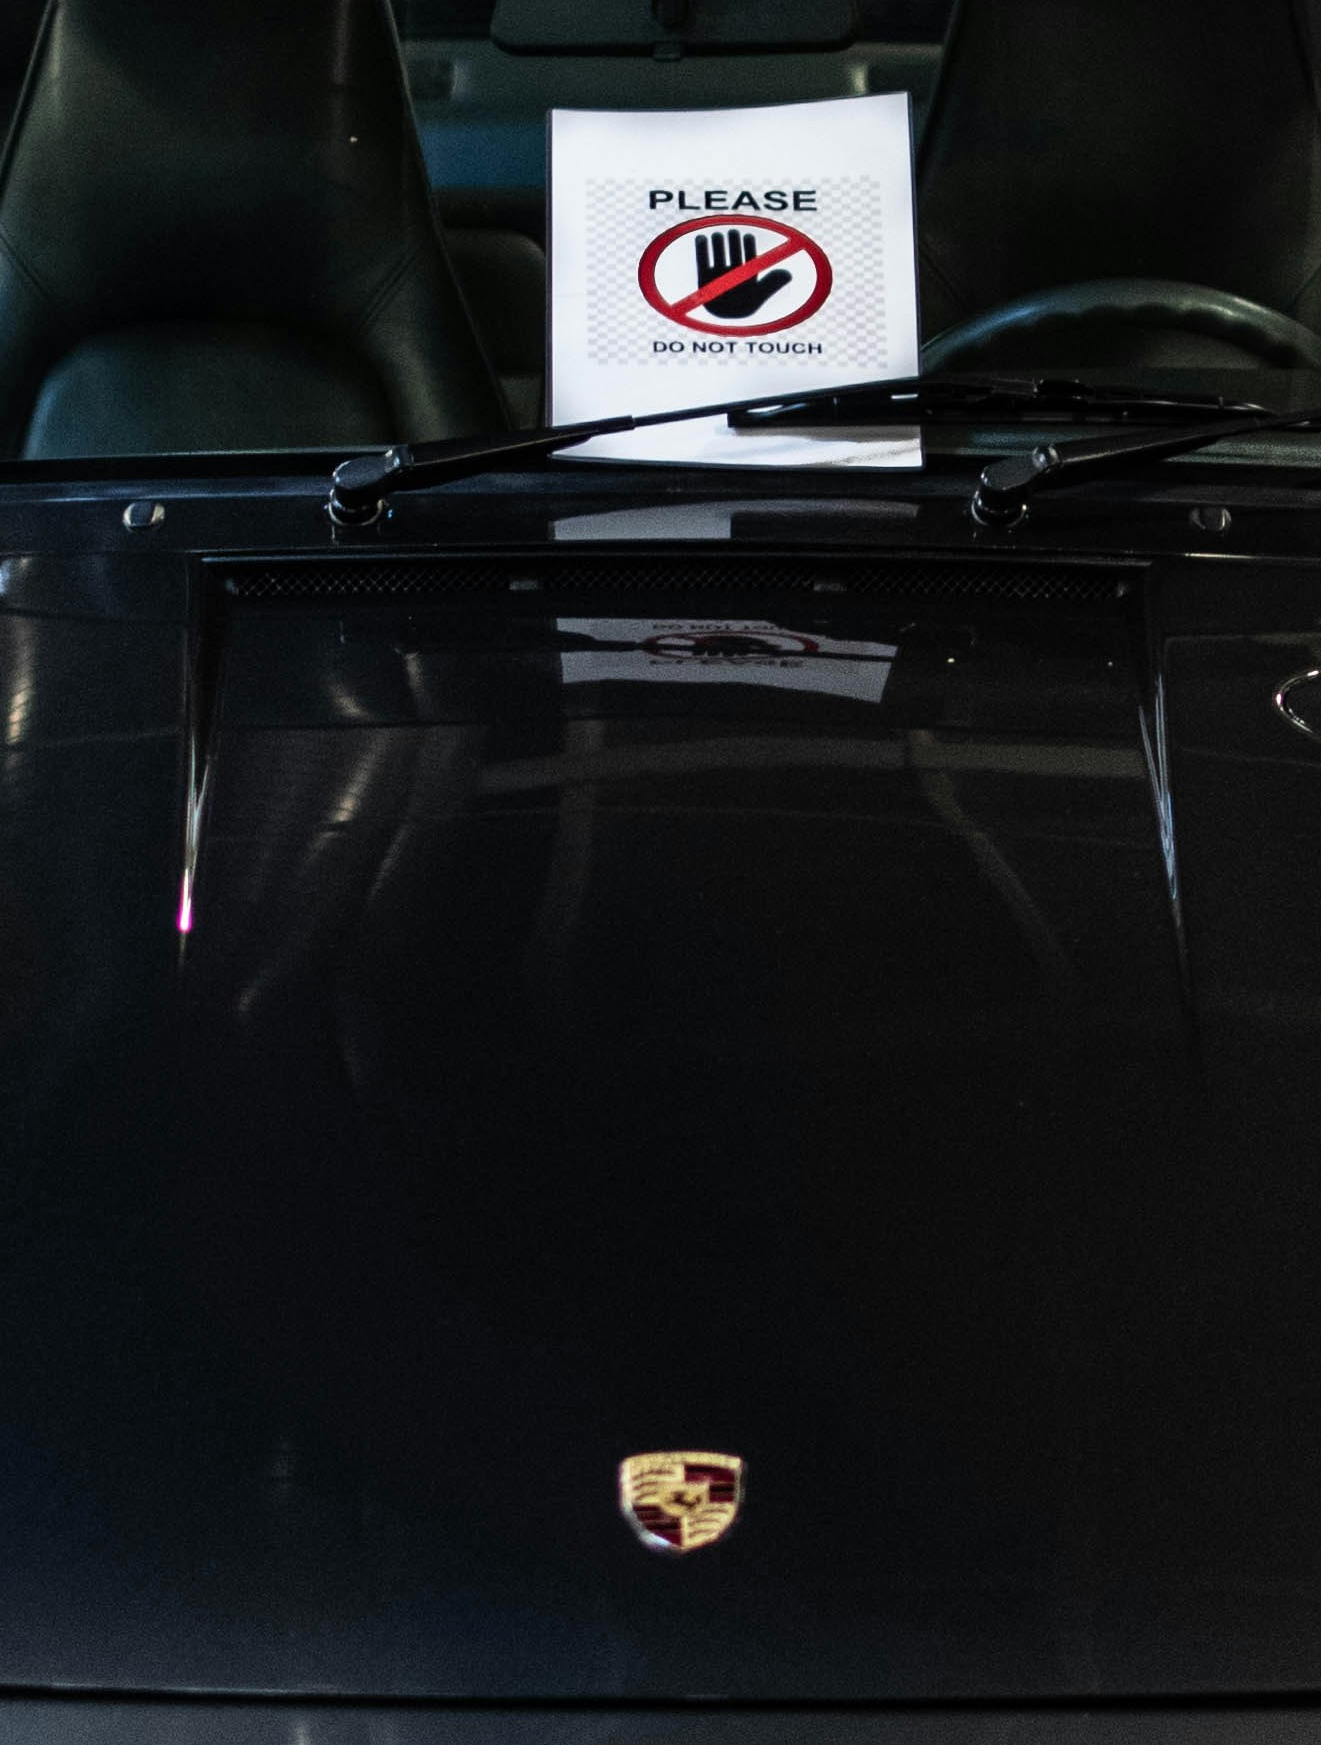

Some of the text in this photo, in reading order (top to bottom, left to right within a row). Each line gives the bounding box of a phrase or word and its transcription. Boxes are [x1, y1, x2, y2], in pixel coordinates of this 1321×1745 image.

[649, 189, 818, 212] PLEASE
[652, 341, 823, 355] DO NOT TOUCH
